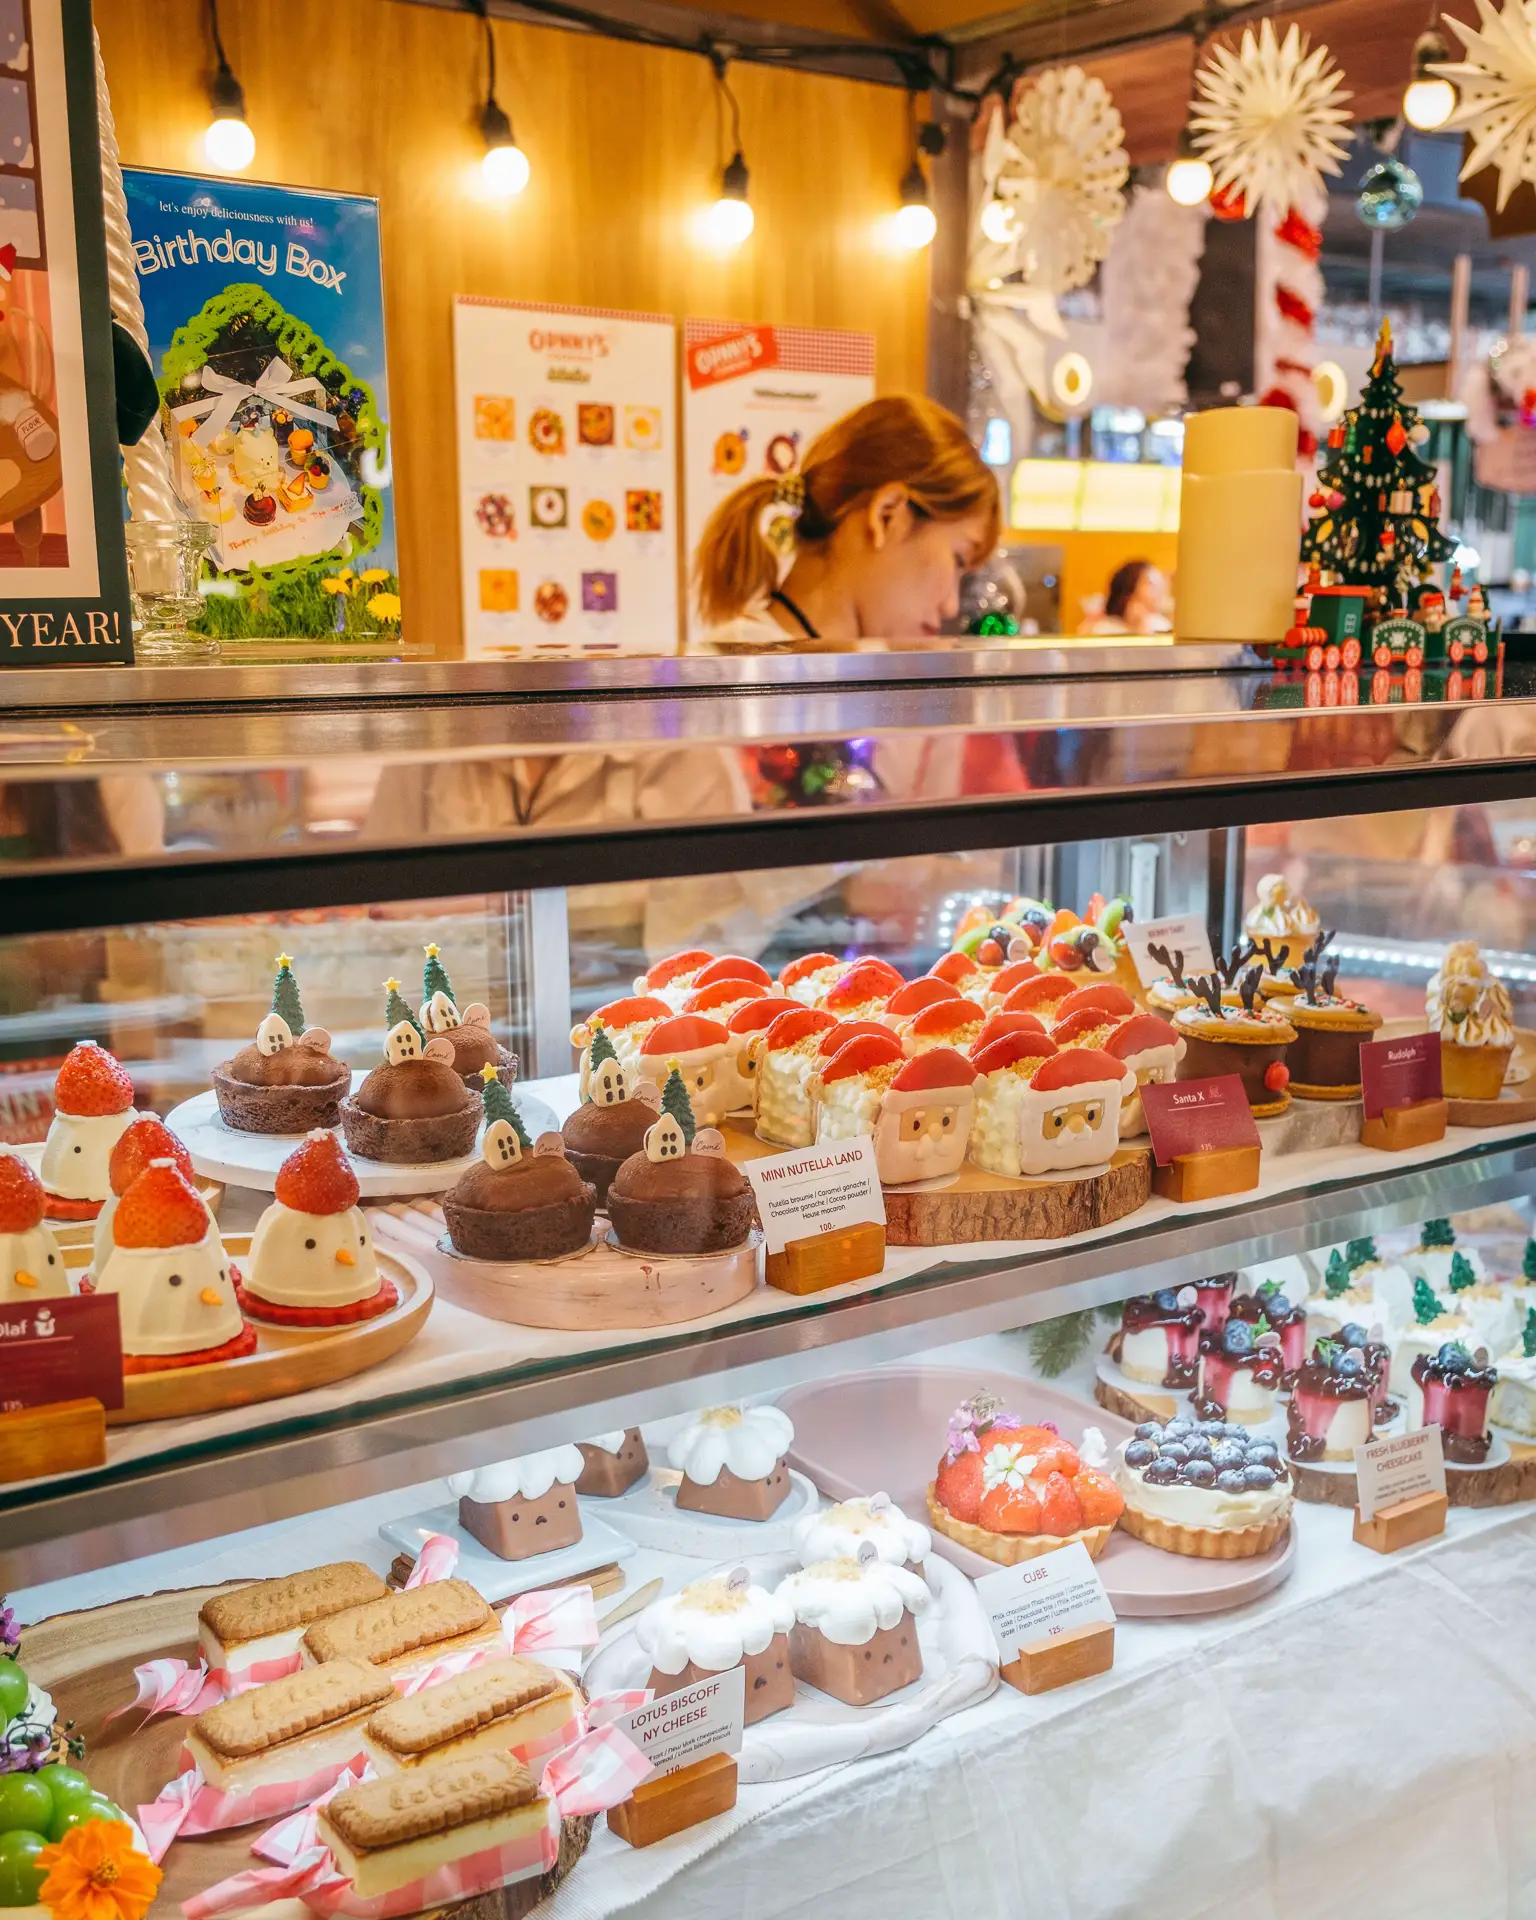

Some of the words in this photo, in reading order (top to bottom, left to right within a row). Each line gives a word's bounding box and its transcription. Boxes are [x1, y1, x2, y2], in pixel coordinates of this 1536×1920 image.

[159, 200, 179, 213] let's
[181, 203, 209, 218] enjoy
[211, 207, 274, 225] deliciousness
[276, 215, 297, 227] with
[299, 217, 314, 228] us!
[131, 229, 277, 276] Birthday
[285, 242, 347, 295] Box
[21, 416, 42, 435] FLOUR
[1, 611, 121, 648] YEAR!
[1387, 1047, 1416, 1061] Rudolph
[1172, 1093, 1197, 1104] Santa
[1196, 1091, 1205, 1101] X
[760, 1167, 786, 1182] MINI
[787, 1156, 834, 1177] NUTELLA
[834, 1150, 863, 1166] LAND
[790, 1192, 814, 1204] brownie
[817, 1185, 842, 1197] Caramel
[843, 1179, 867, 1192] ganache
[770, 1205, 799, 1218] Chocolate
[800, 1199, 825, 1212] ganache
[828, 1194, 847, 1204] Cocoa
[847, 1188, 868, 1200] powder
[802, 1210, 820, 1220] House
[820, 1204, 846, 1215] macaron
[819, 1222, 836, 1232] 100.-
[1366, 1446, 1388, 1460] FRESH
[1389, 1433, 1429, 1453] BLUEBERRY
[1376, 1450, 1423, 1472] CHEESECAKE
[1022, 1567, 1049, 1584] CUBE
[1000, 1619, 1014, 1628] cake
[1016, 1608, 1043, 1622] Chocolate
[631, 1704, 668, 1730] LOTUS
[670, 1682, 720, 1713] BISCOFF
[643, 1726, 661, 1743] NY
[662, 1706, 708, 1734] CHEESE
[696, 1724, 729, 1742] cheesecake
[693, 1737, 712, 1750] biscoff
